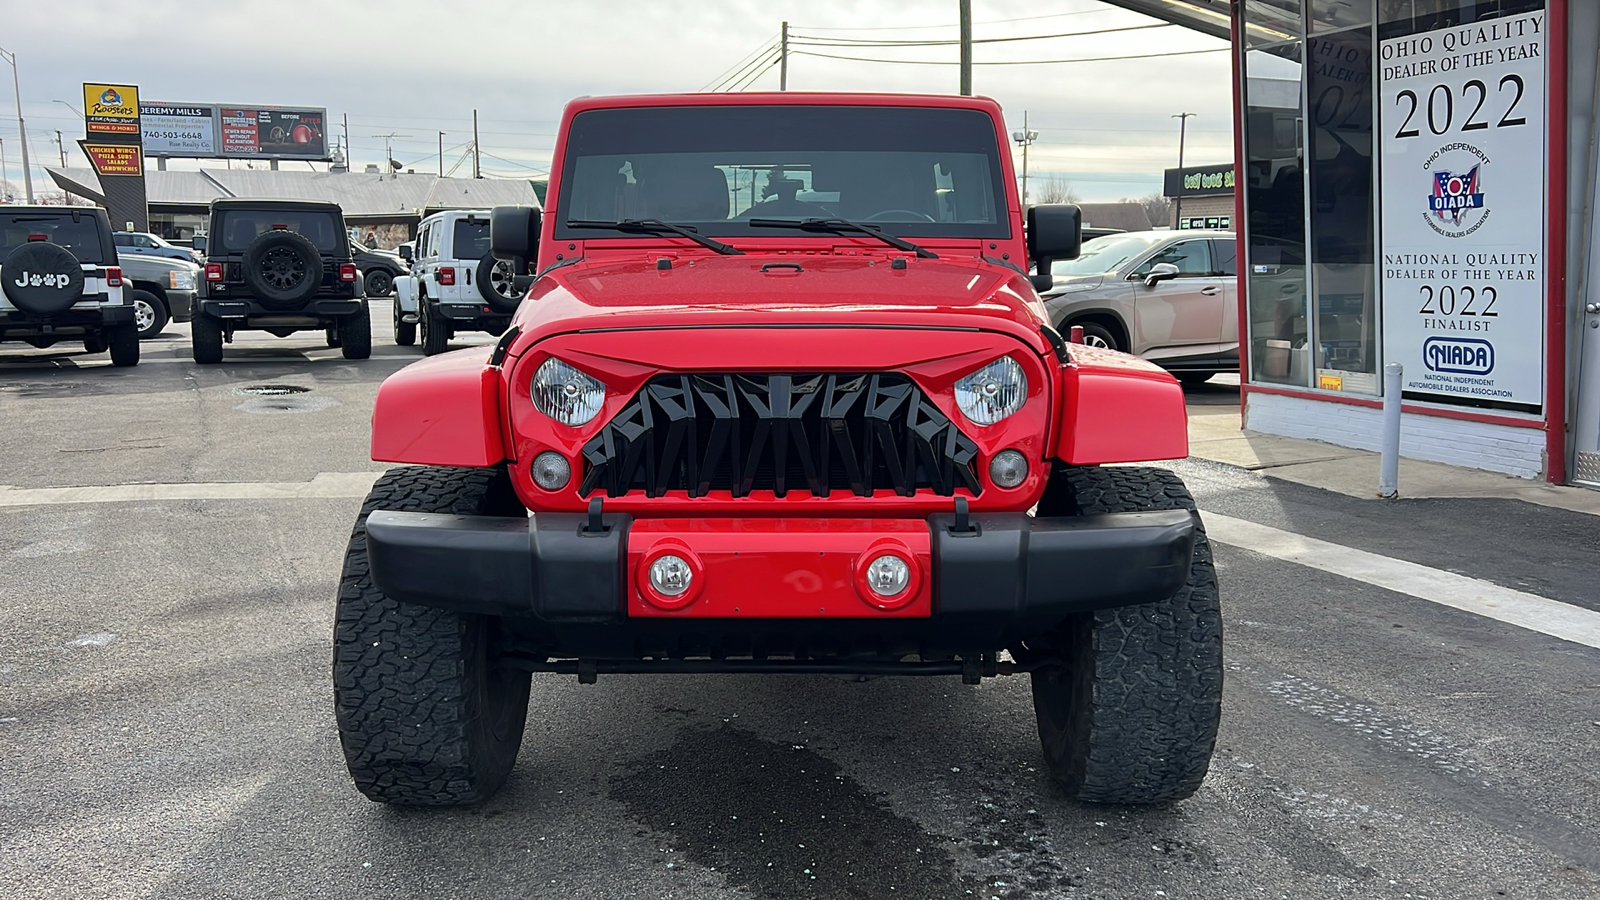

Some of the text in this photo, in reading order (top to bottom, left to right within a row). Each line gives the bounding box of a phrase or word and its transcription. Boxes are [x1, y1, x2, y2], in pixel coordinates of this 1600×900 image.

[1381, 16, 1543, 60] OHIO QUALITY
[1384, 43, 1540, 81] DEALER OF THE YEAR
[91, 102, 134, 116] Roosters
[140, 107, 202, 116] JEREMY MILLS
[1395, 73, 1527, 139] 2022
[143, 131, 203, 139] 740-503-6648
[182, 141, 200, 149] Realty
[1423, 142, 1491, 170] OHIO INDEPENDENT
[1434, 194, 1475, 210] OIADA
[1422, 208, 1491, 238] AUTOMOBILE DEALERS ASSOCIATION
[1385, 253, 1538, 267] NATIONAL QUALITY
[1386, 269, 1536, 280] DEALER OF THE YEAR
[1419, 285, 1499, 317] 2022
[1424, 319, 1491, 331] FINALIST
[1429, 345, 1487, 368] NIADA
[1424, 374, 1494, 386] NATIONAL INDEPENDENT
[1408, 382, 1513, 397] AUTOMOBILE DEALERS ASSOCIATION
